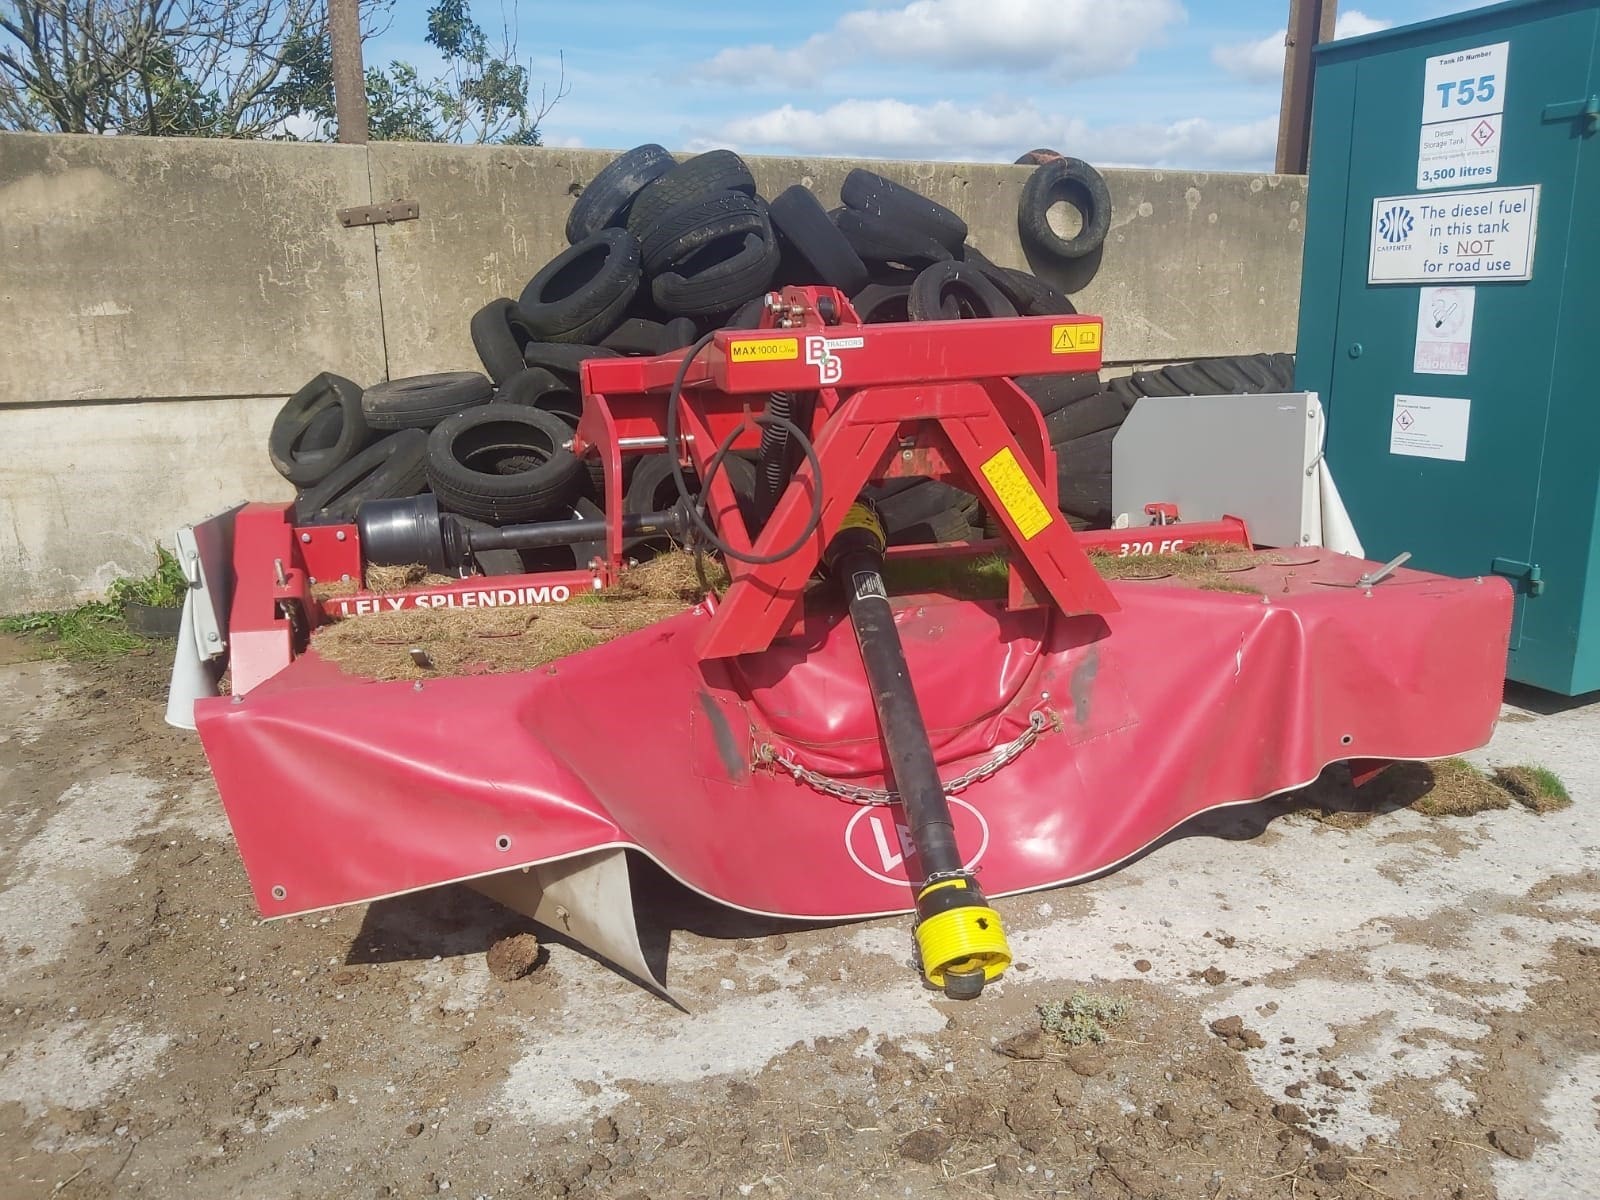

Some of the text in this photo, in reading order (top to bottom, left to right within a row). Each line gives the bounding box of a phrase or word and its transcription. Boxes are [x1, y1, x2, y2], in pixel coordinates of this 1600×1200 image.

[1466, 51, 1492, 61] Number
[1437, 75, 1495, 108] T55
[1434, 128, 1454, 138] Diesel
[1424, 136, 1464, 149] Storage Tank
[1422, 165, 1492, 182] 3,500 litres
[1420, 198, 1527, 219] The diesel fuel
[1429, 219, 1510, 237] in this tank
[1377, 244, 1412, 252] CARPENTER
[1438, 240, 1495, 255] is NOT
[1423, 259, 1511, 272] for road use
[733, 346, 757, 356] MAX
[758, 345, 778, 354] 1000
[826, 339, 862, 348] TRACTORS
[1118, 541, 1153, 557] 320
[414, 585, 570, 609] SPLENDIMO
